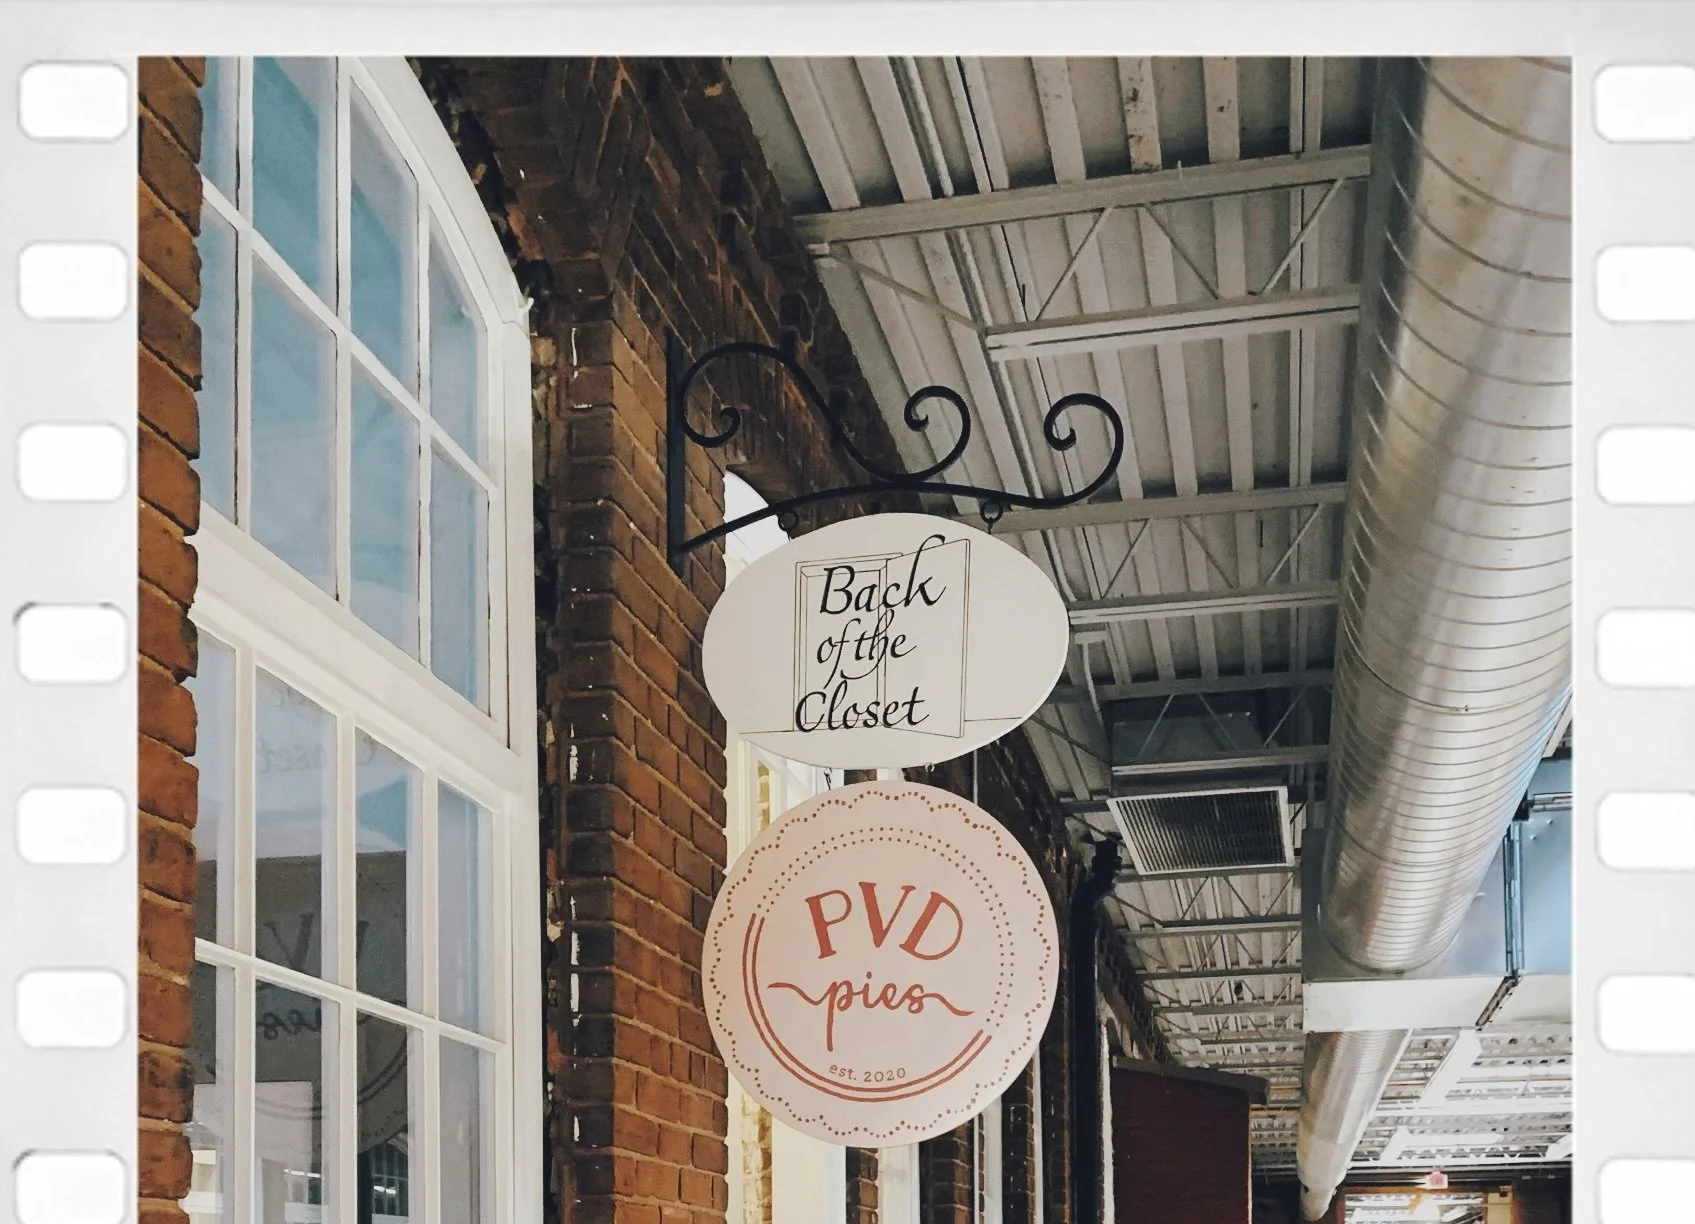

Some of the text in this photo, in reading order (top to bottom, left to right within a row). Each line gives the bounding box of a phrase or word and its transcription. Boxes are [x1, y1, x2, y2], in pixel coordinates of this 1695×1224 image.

[820, 533, 946, 615] Back
[816, 607, 917, 689] of the
[795, 679, 930, 733] Closet
[805, 881, 963, 960] PVD
[767, 971, 976, 1052] pies
[829, 1064, 906, 1082] est. 2020
